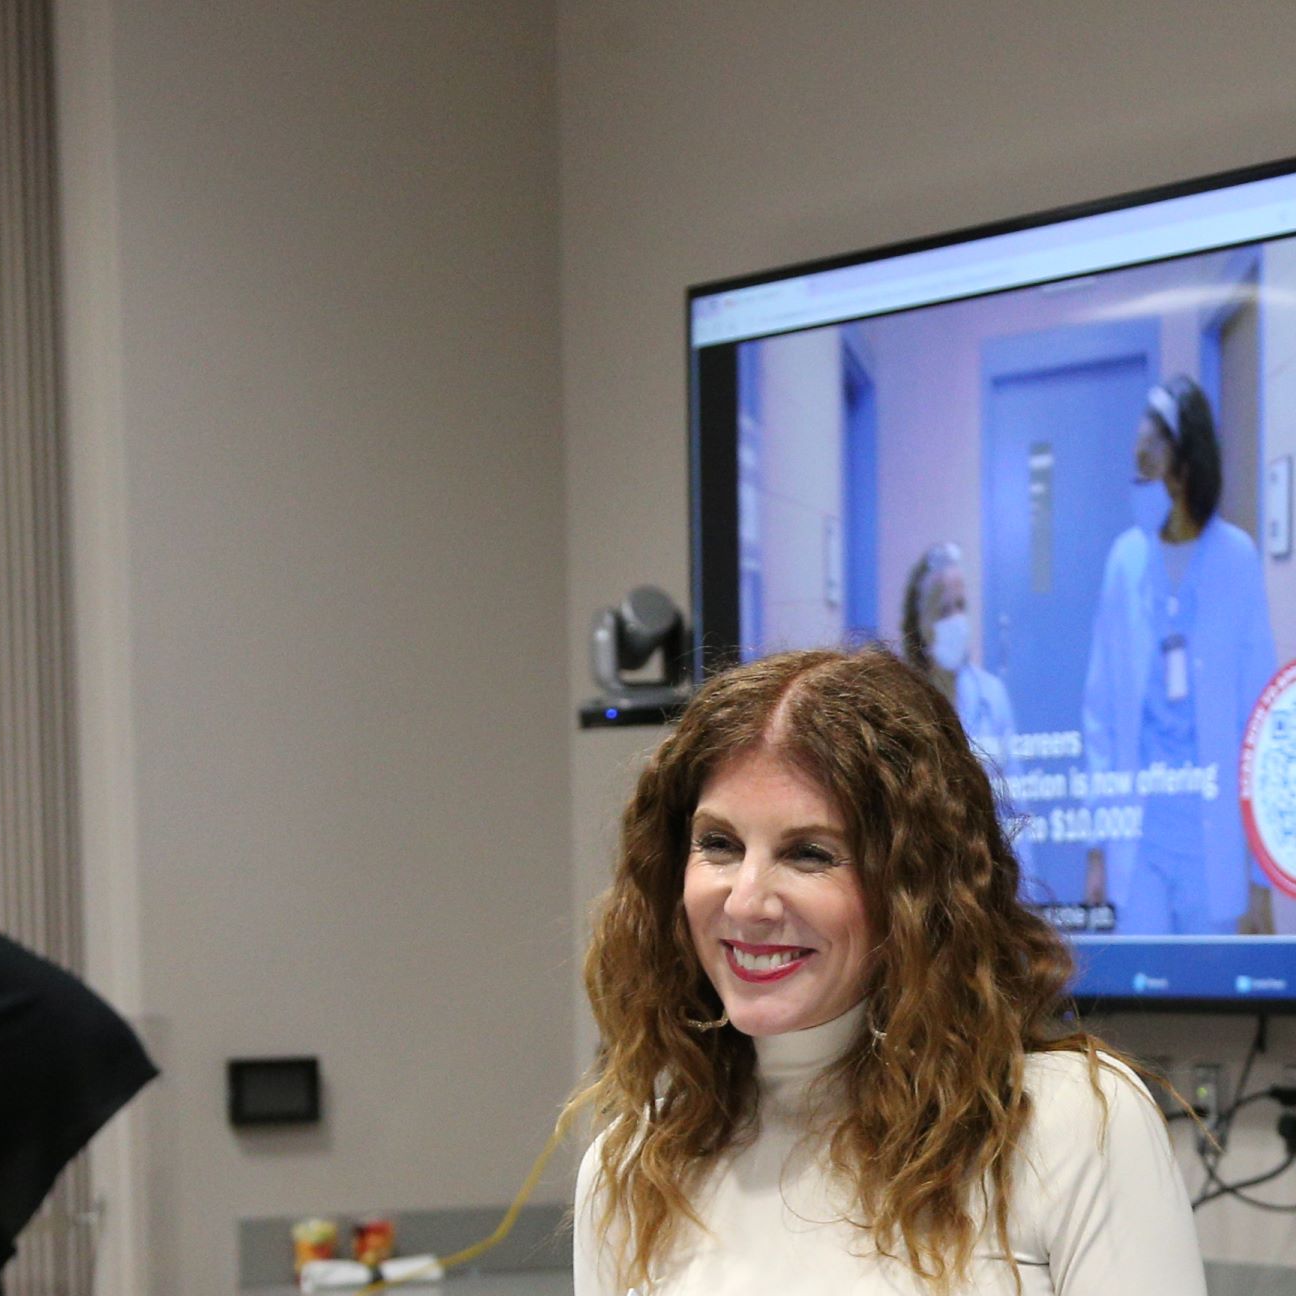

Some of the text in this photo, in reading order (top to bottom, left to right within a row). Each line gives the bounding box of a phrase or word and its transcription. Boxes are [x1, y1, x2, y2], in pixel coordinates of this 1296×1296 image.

[1010, 730, 1082, 757] careers
[1069, 766, 1089, 796] is
[1091, 771, 1132, 795] now
[1136, 761, 1219, 800] offering
[1051, 805, 1144, 844] $10,000!
